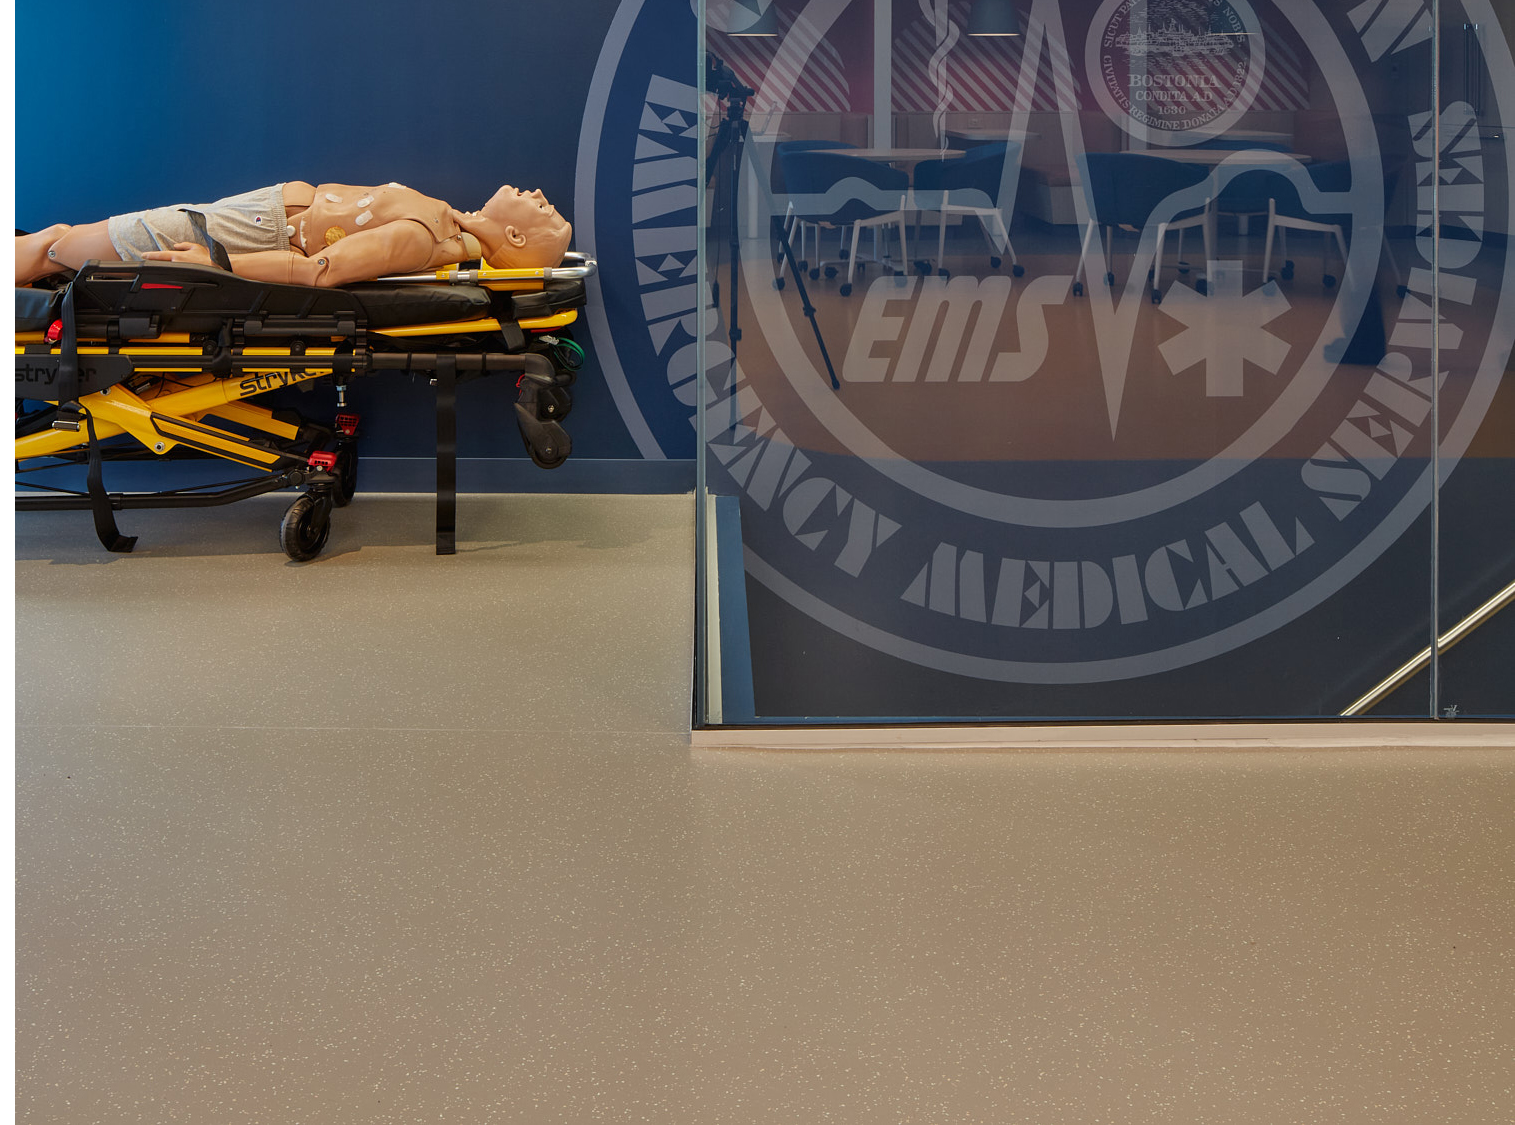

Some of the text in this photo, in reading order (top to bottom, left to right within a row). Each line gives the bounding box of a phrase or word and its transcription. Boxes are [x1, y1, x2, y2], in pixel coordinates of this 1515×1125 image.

[1103, 13, 1123, 48] SICUT
[1128, 74, 1222, 88] BOSTONIA
[1135, 90, 1189, 101] CONDITA
[1158, 105, 1186, 115] 1630
[842, 274, 1072, 383] EMS
[631, 74, 1484, 629] EMERGENCY MEDICAL SERVICES
[15, 363, 97, 385] stryer
